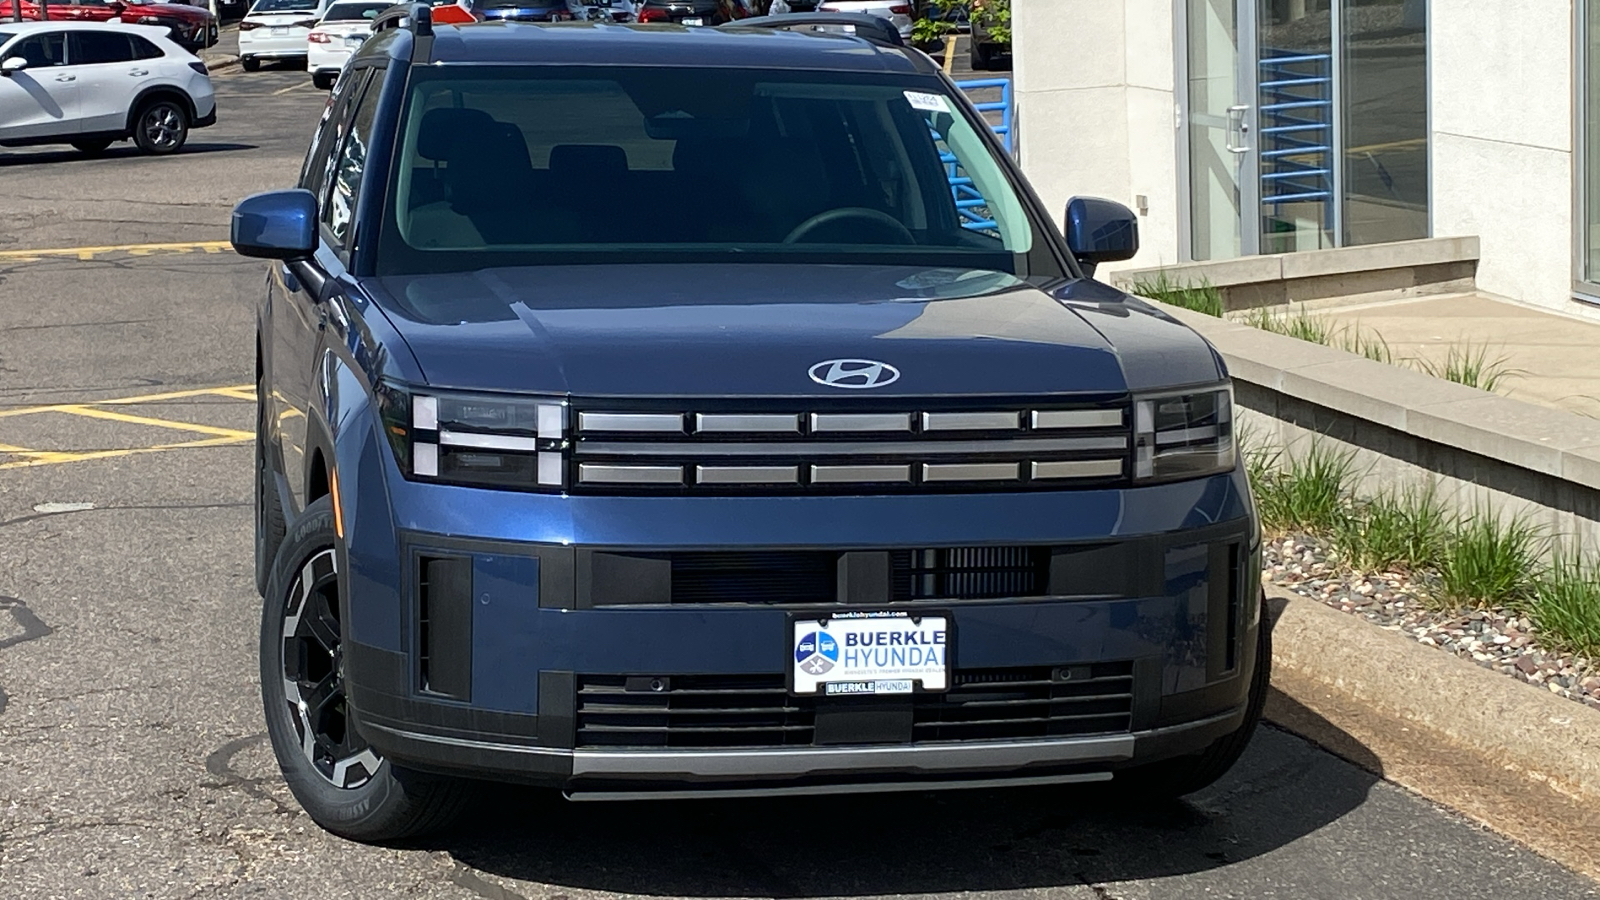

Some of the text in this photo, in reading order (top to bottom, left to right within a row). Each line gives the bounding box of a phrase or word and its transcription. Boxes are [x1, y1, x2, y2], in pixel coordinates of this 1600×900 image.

[832, 611, 908, 619] buerklehyundai.com
[845, 630, 946, 647] BUERKLE
[844, 646, 945, 668] HYUNDAI
[828, 681, 911, 693] BUERKLE HYUNDAI
